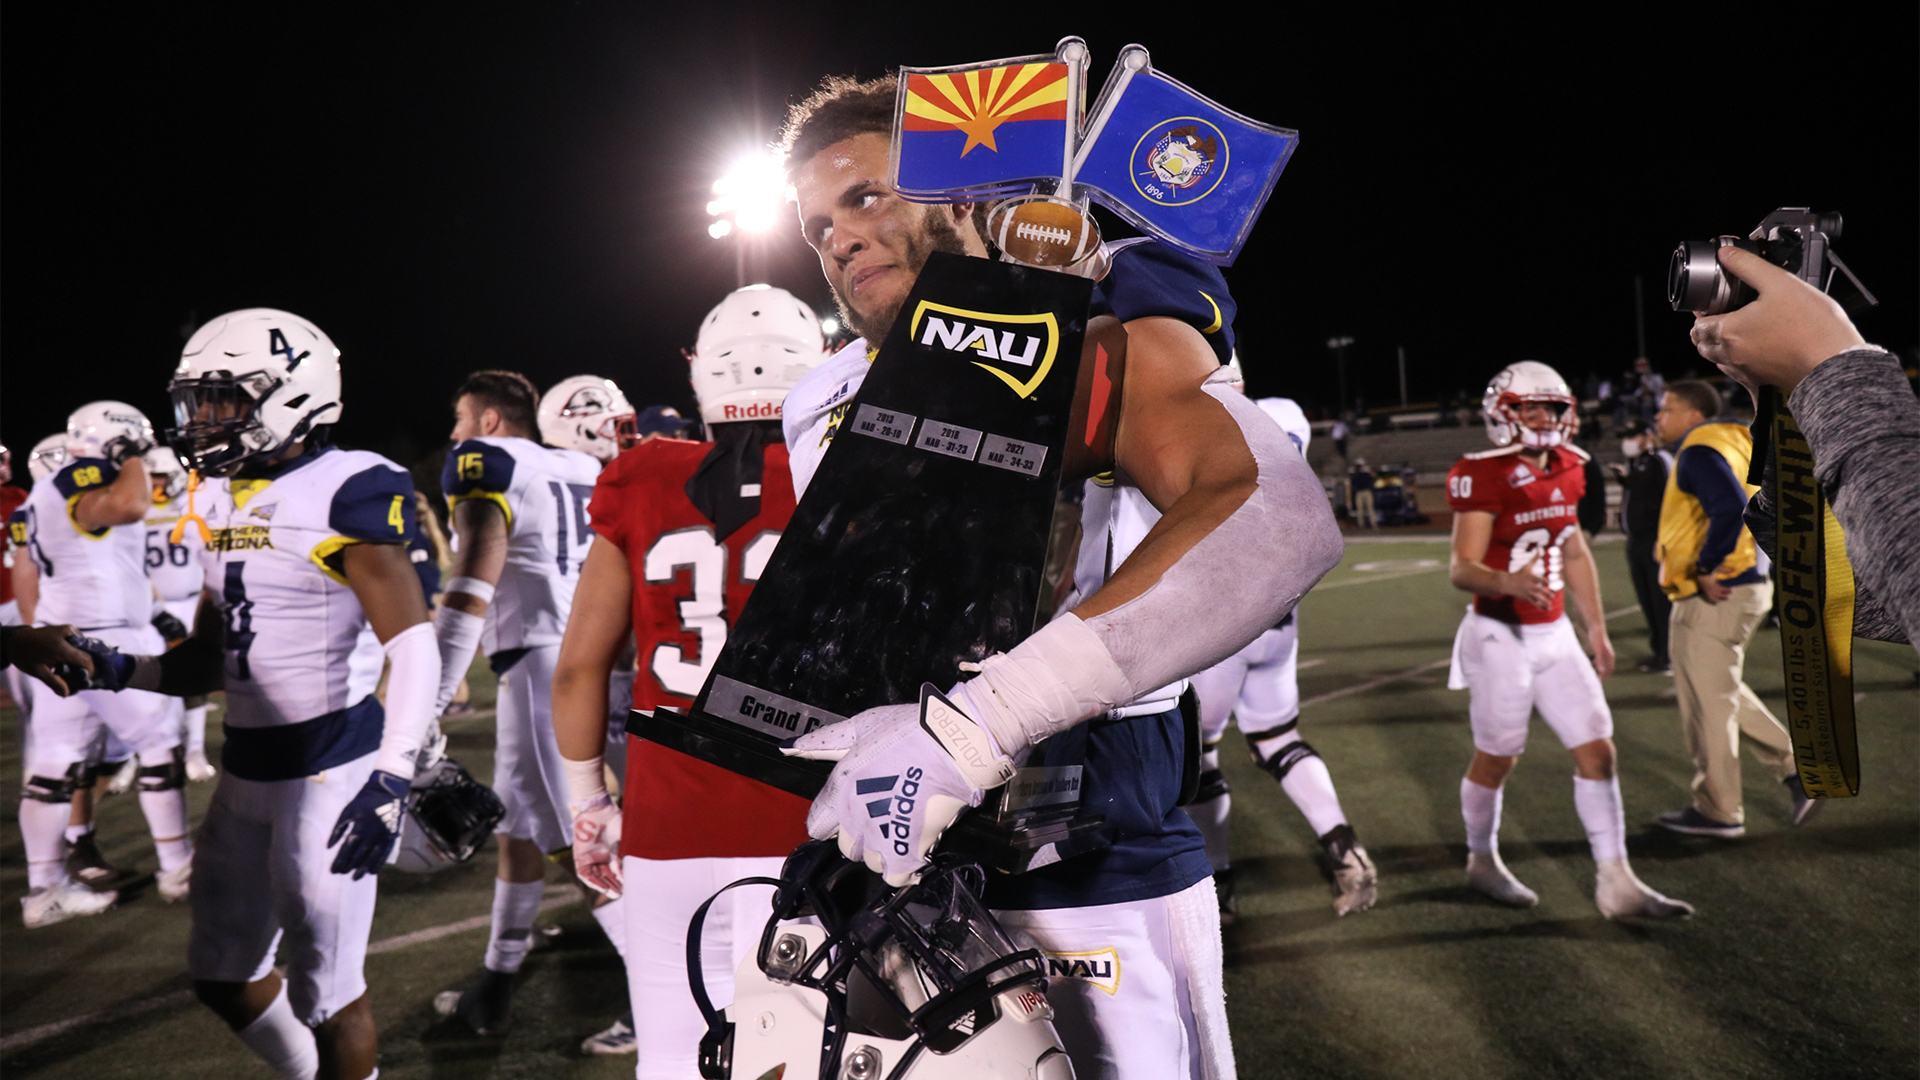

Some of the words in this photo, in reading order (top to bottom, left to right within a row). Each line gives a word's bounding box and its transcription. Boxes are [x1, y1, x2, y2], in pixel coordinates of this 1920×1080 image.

[1144, 183, 1164, 199] 1896
[270, 328, 294, 361] 4
[921, 316, 1041, 367] NAU
[860, 421, 876, 432] NAU
[924, 436, 940, 448] NAU
[945, 441, 969, 455] 31-23
[987, 451, 1003, 463] NAU
[1010, 456, 1035, 471] 34-33
[1005, 442, 1025, 455] 2021
[457, 453, 484, 481] 15
[388, 496, 405, 534] 4
[144, 531, 189, 568] 56
[1812, 636, 1826, 688] System
[739, 695, 801, 732] Grand
[1791, 672, 1813, 730] 5,400
[931, 706, 988, 769] ADIZERO
[890, 766, 923, 856] adidas
[1048, 959, 1112, 979] NAU
